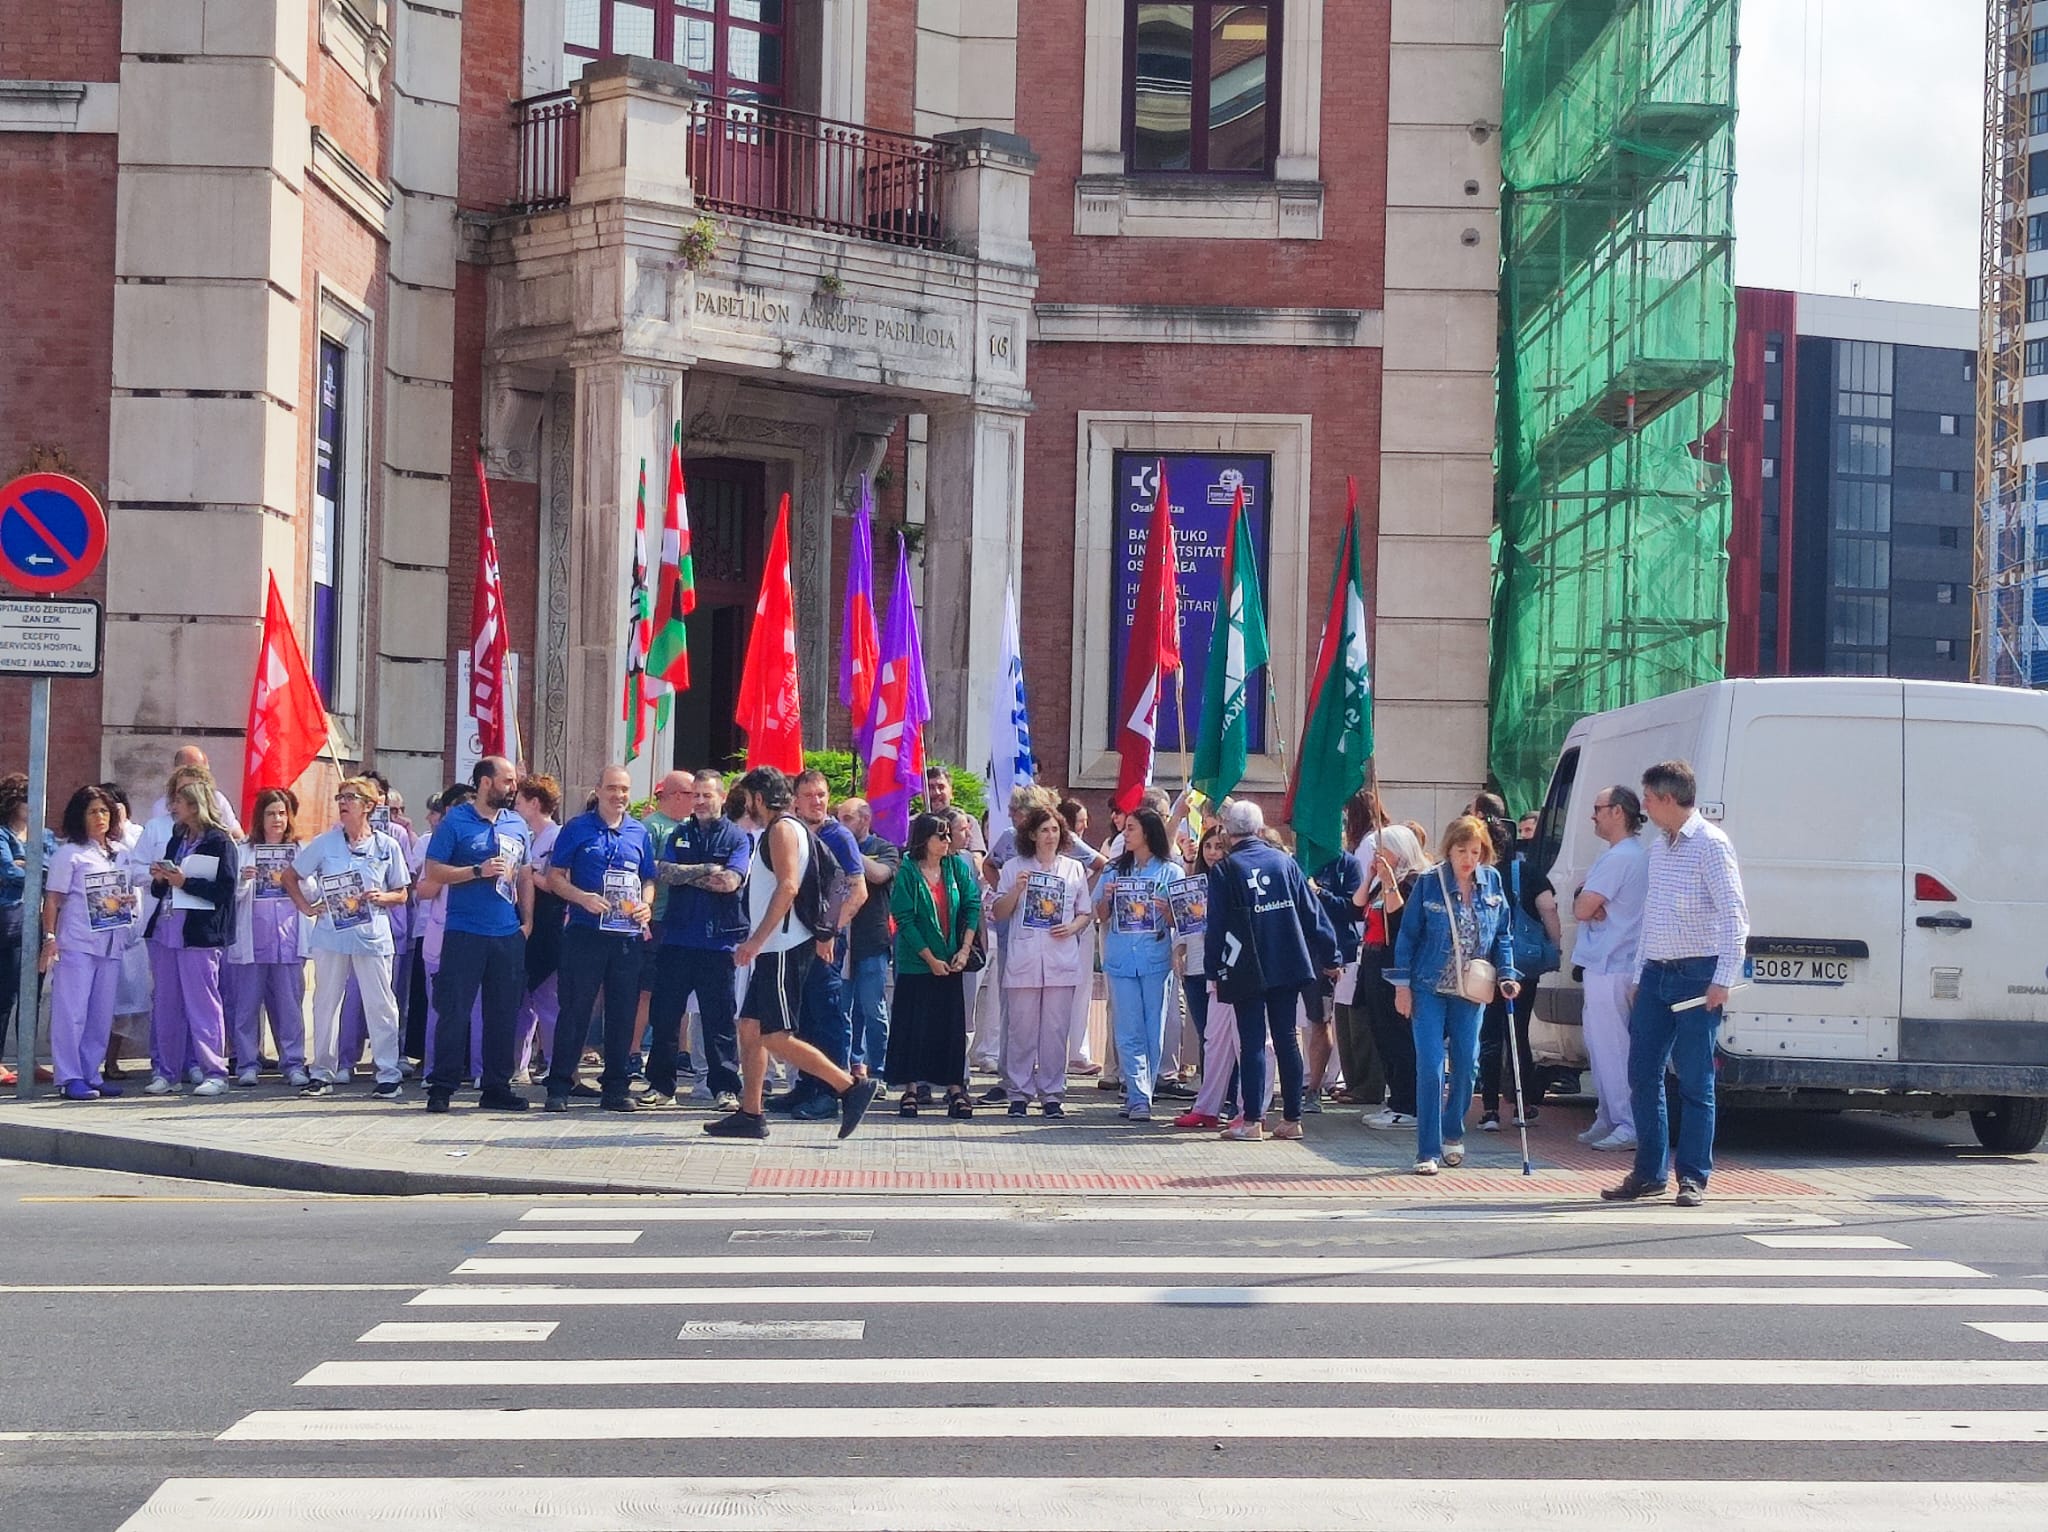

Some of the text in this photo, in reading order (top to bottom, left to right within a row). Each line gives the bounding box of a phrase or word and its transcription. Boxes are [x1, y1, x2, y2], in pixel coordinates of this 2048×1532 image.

[695, 292, 789, 323] PABELLON
[799, 308, 868, 337] ARRUPE
[990, 334, 1008, 358] 16
[1129, 529, 1207, 541] BATUKO
[22, 615, 61, 624] IZAN EZIK
[22, 632, 60, 641] EXCEPTO
[43, 643, 82, 652] HOSPITAL
[70, 660, 75, 668] 2
[1769, 944, 1837, 954] MASTER
[1755, 960, 1848, 979] 5087 MCC
